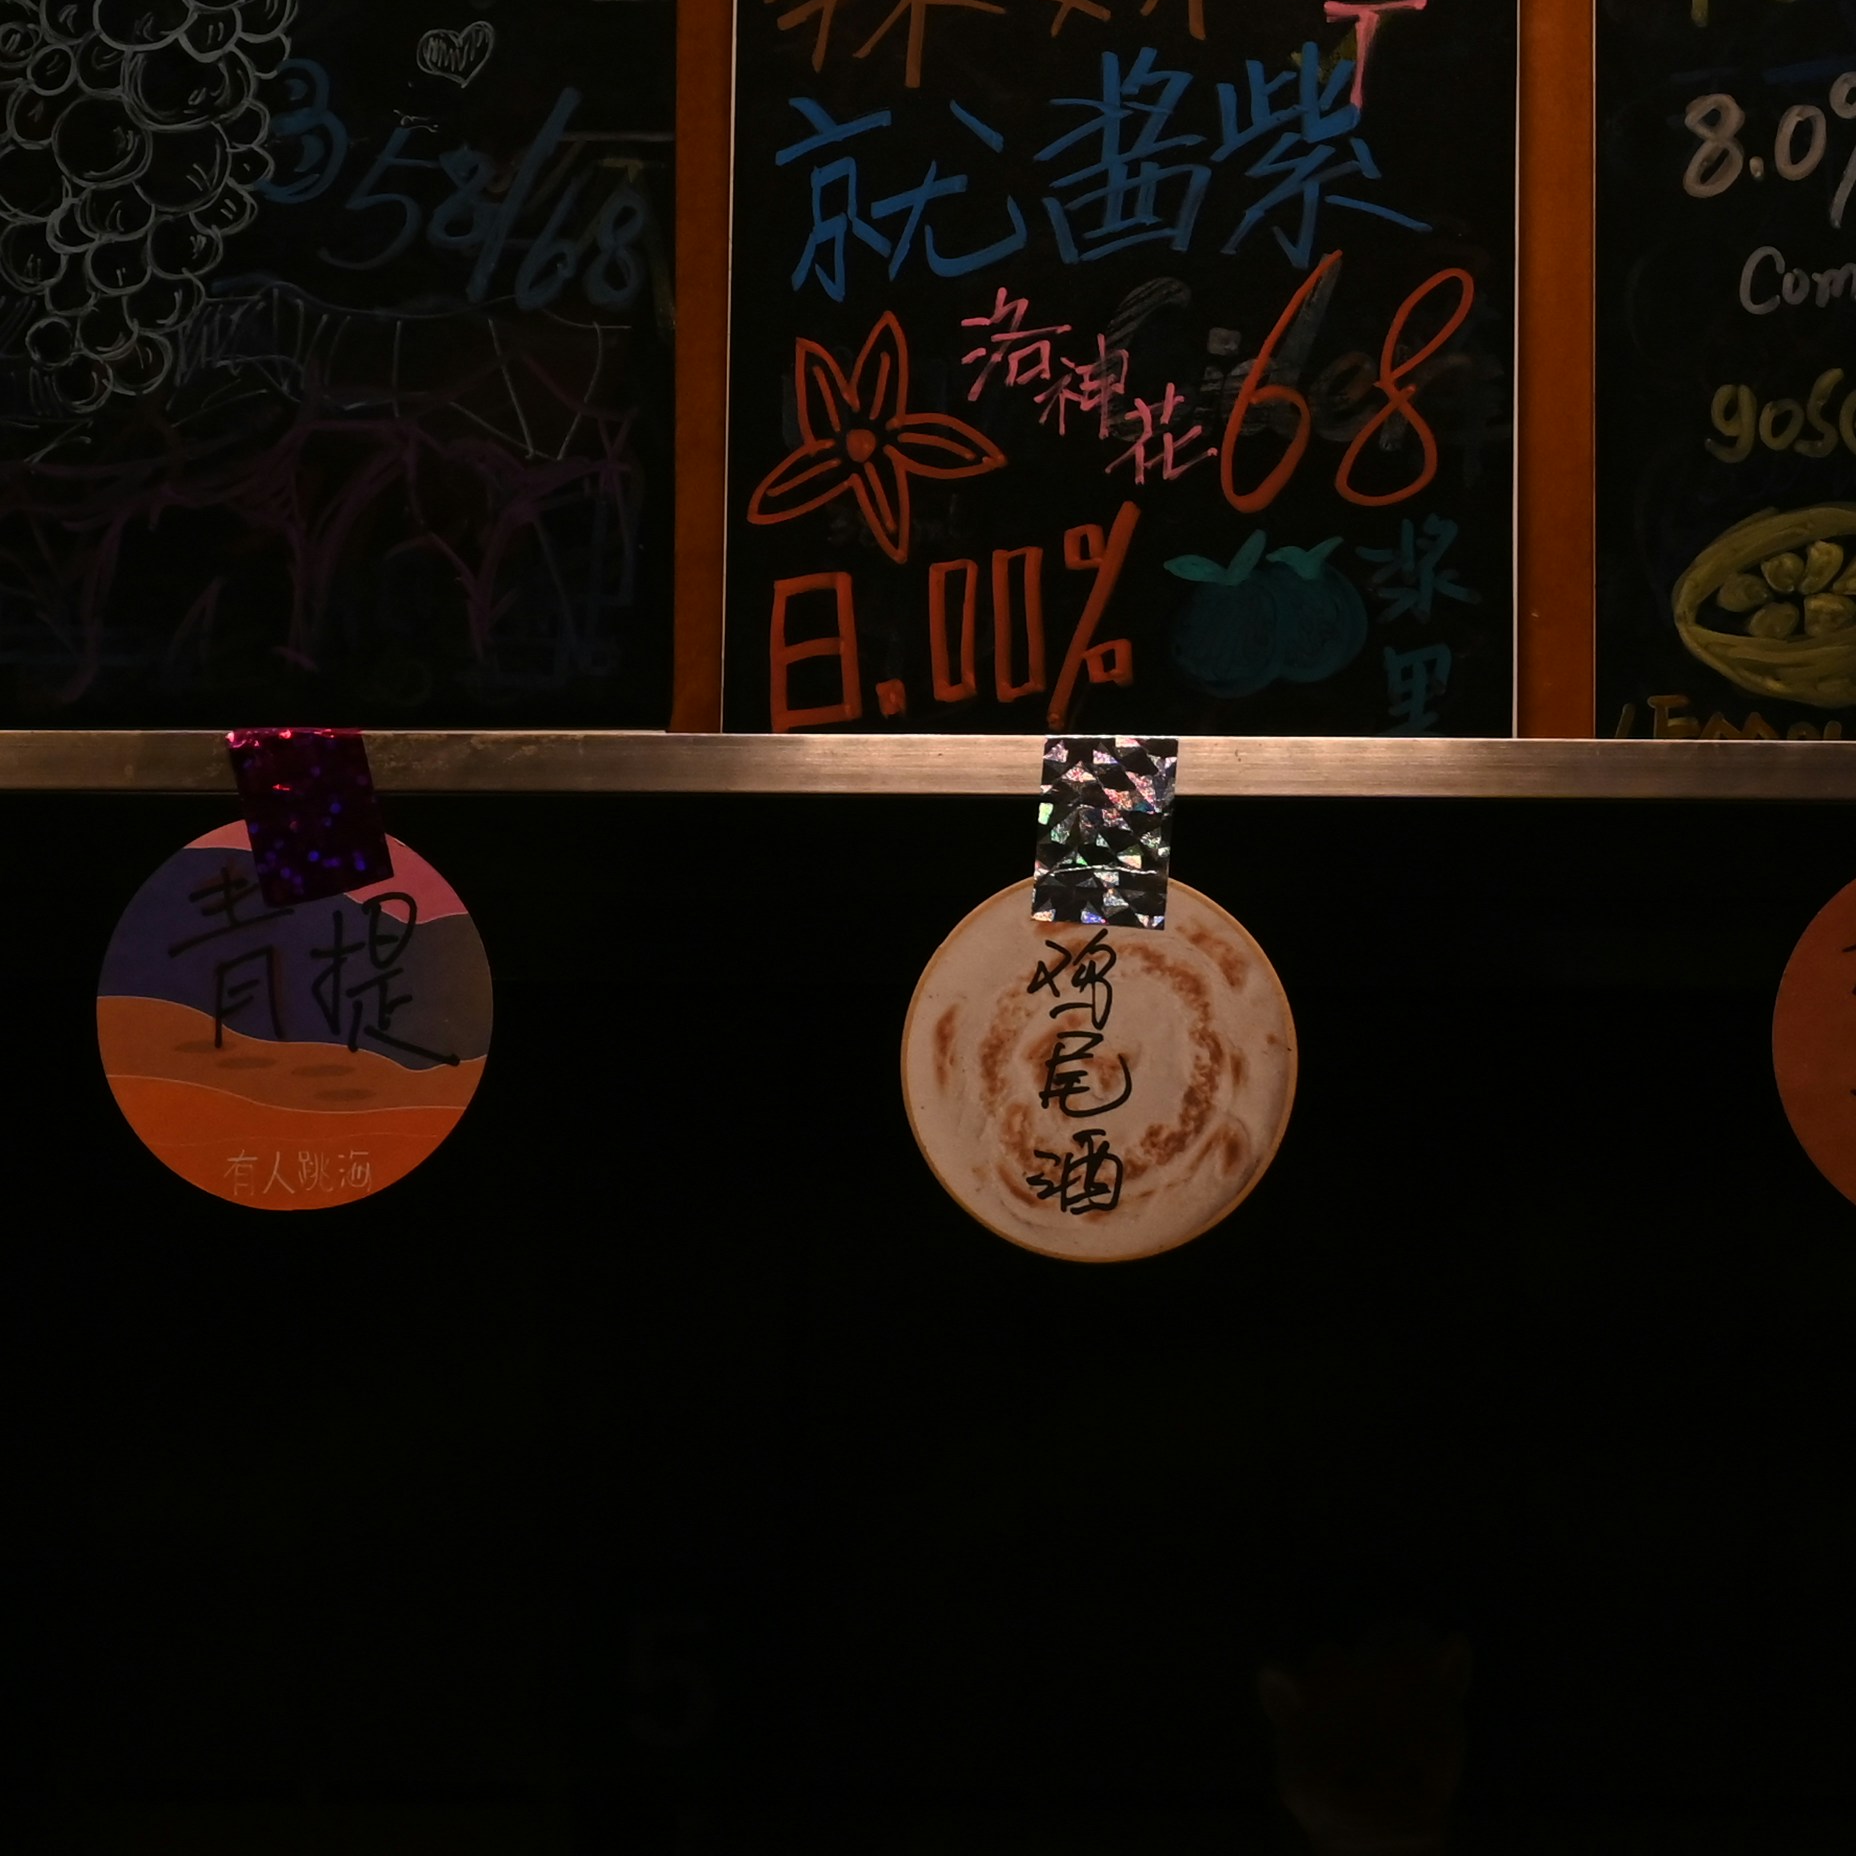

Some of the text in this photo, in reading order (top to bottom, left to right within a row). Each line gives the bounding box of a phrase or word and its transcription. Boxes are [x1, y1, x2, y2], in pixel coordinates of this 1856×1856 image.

[1220, 249, 1475, 514] 68
[166, 865, 461, 1066] 青提
[224, 1147, 374, 1197] 有人跳海
